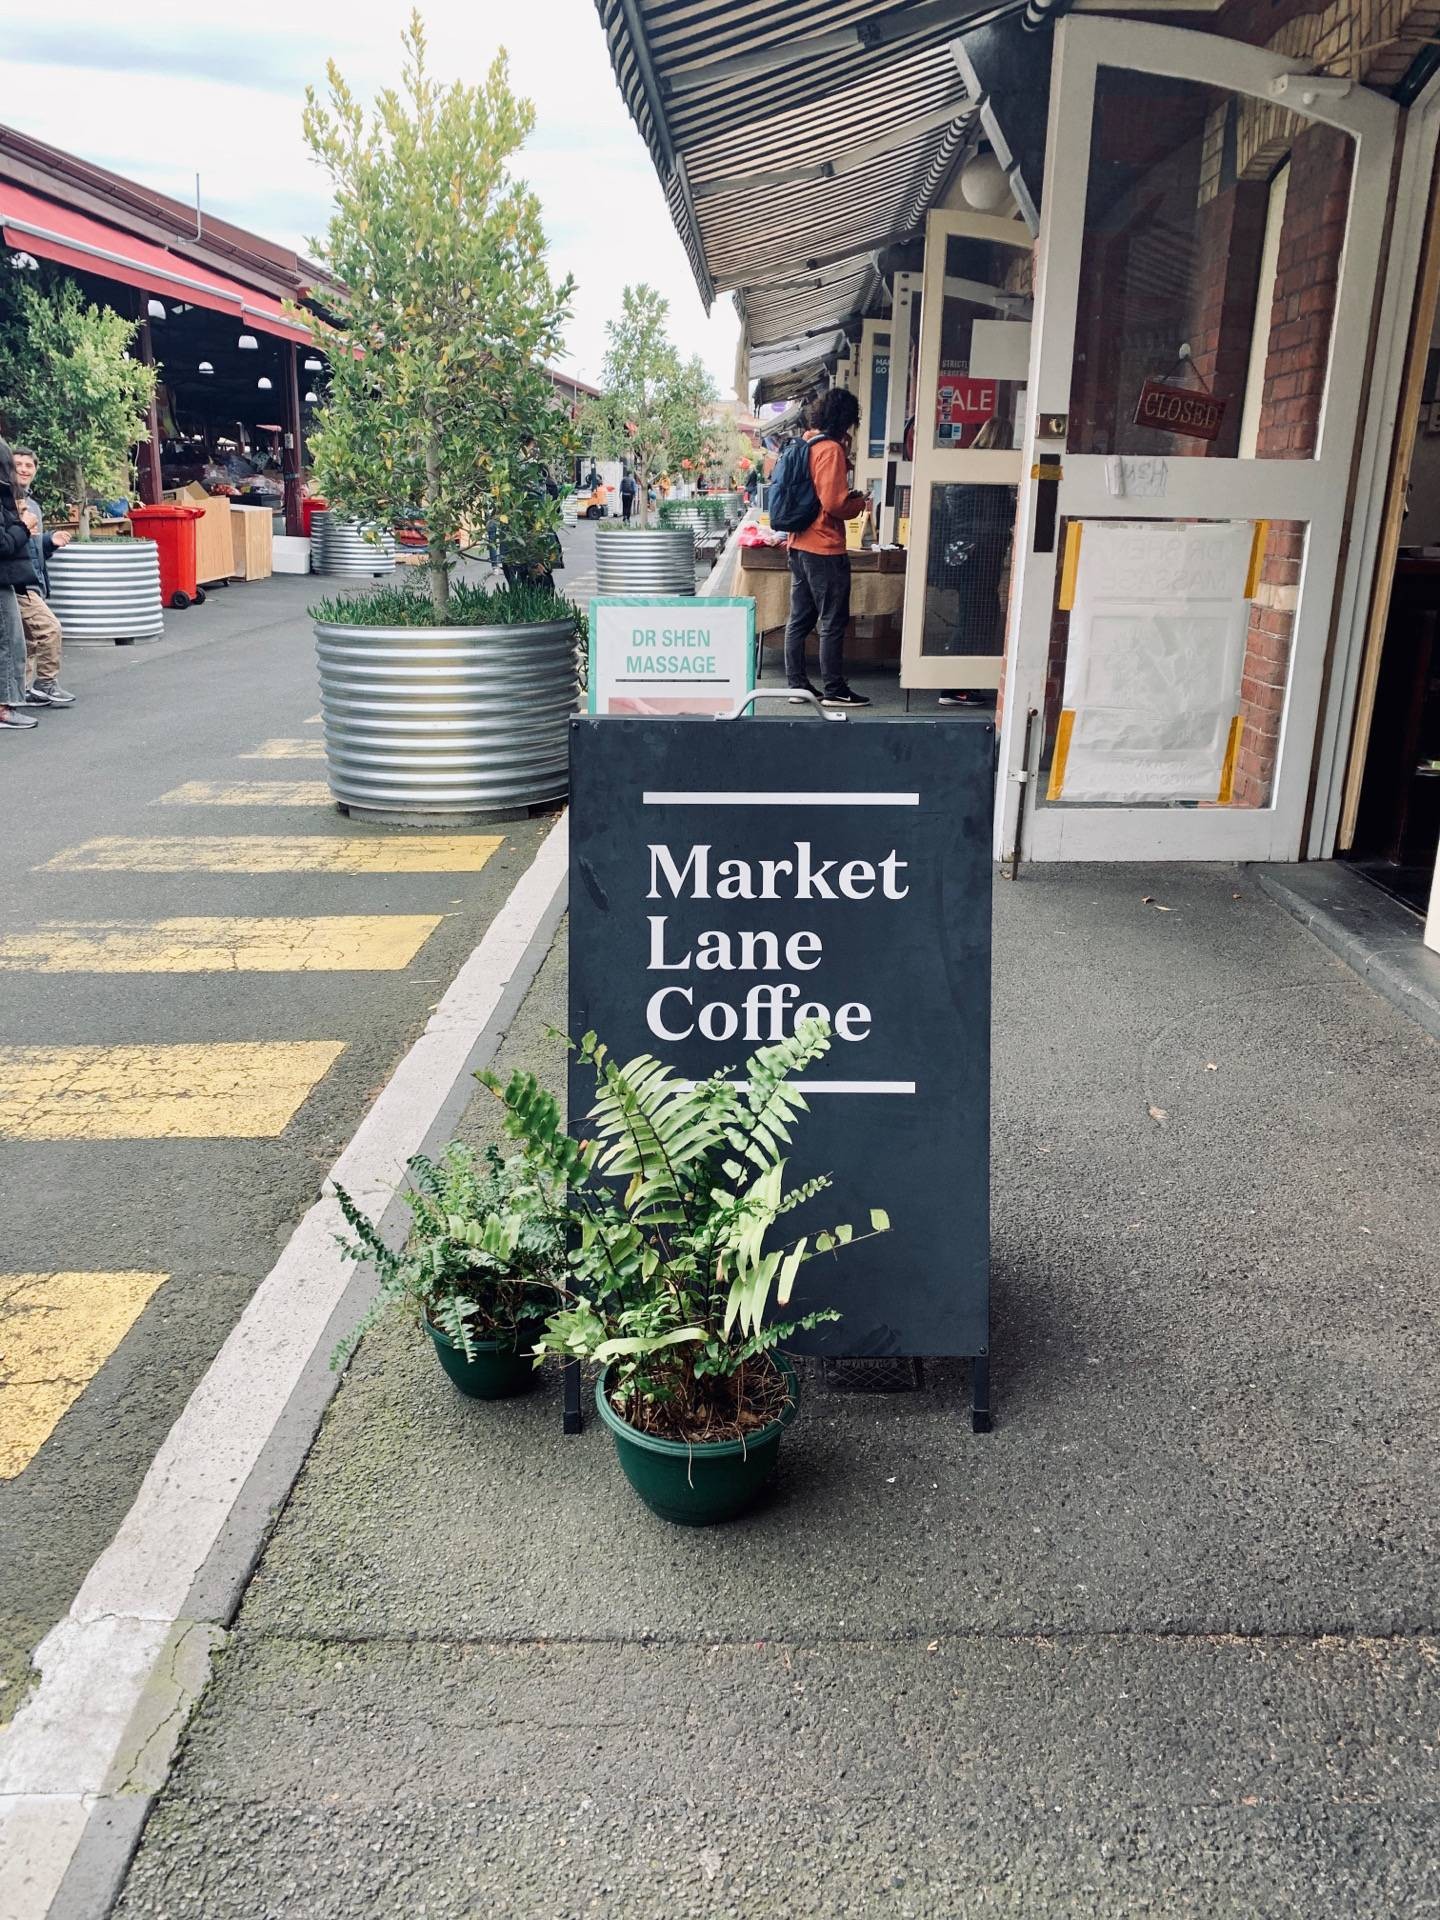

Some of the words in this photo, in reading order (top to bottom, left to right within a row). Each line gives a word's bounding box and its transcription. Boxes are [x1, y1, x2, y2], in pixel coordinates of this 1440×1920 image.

[1145, 392, 1219, 429] CLOSED
[632, 629, 656, 647] DR
[662, 629, 711, 648] SHEN
[626, 655, 717, 674] MASSAGE
[645, 841, 910, 900] Market
[646, 915, 823, 971] Lane
[646, 983, 873, 1042] Coffee
